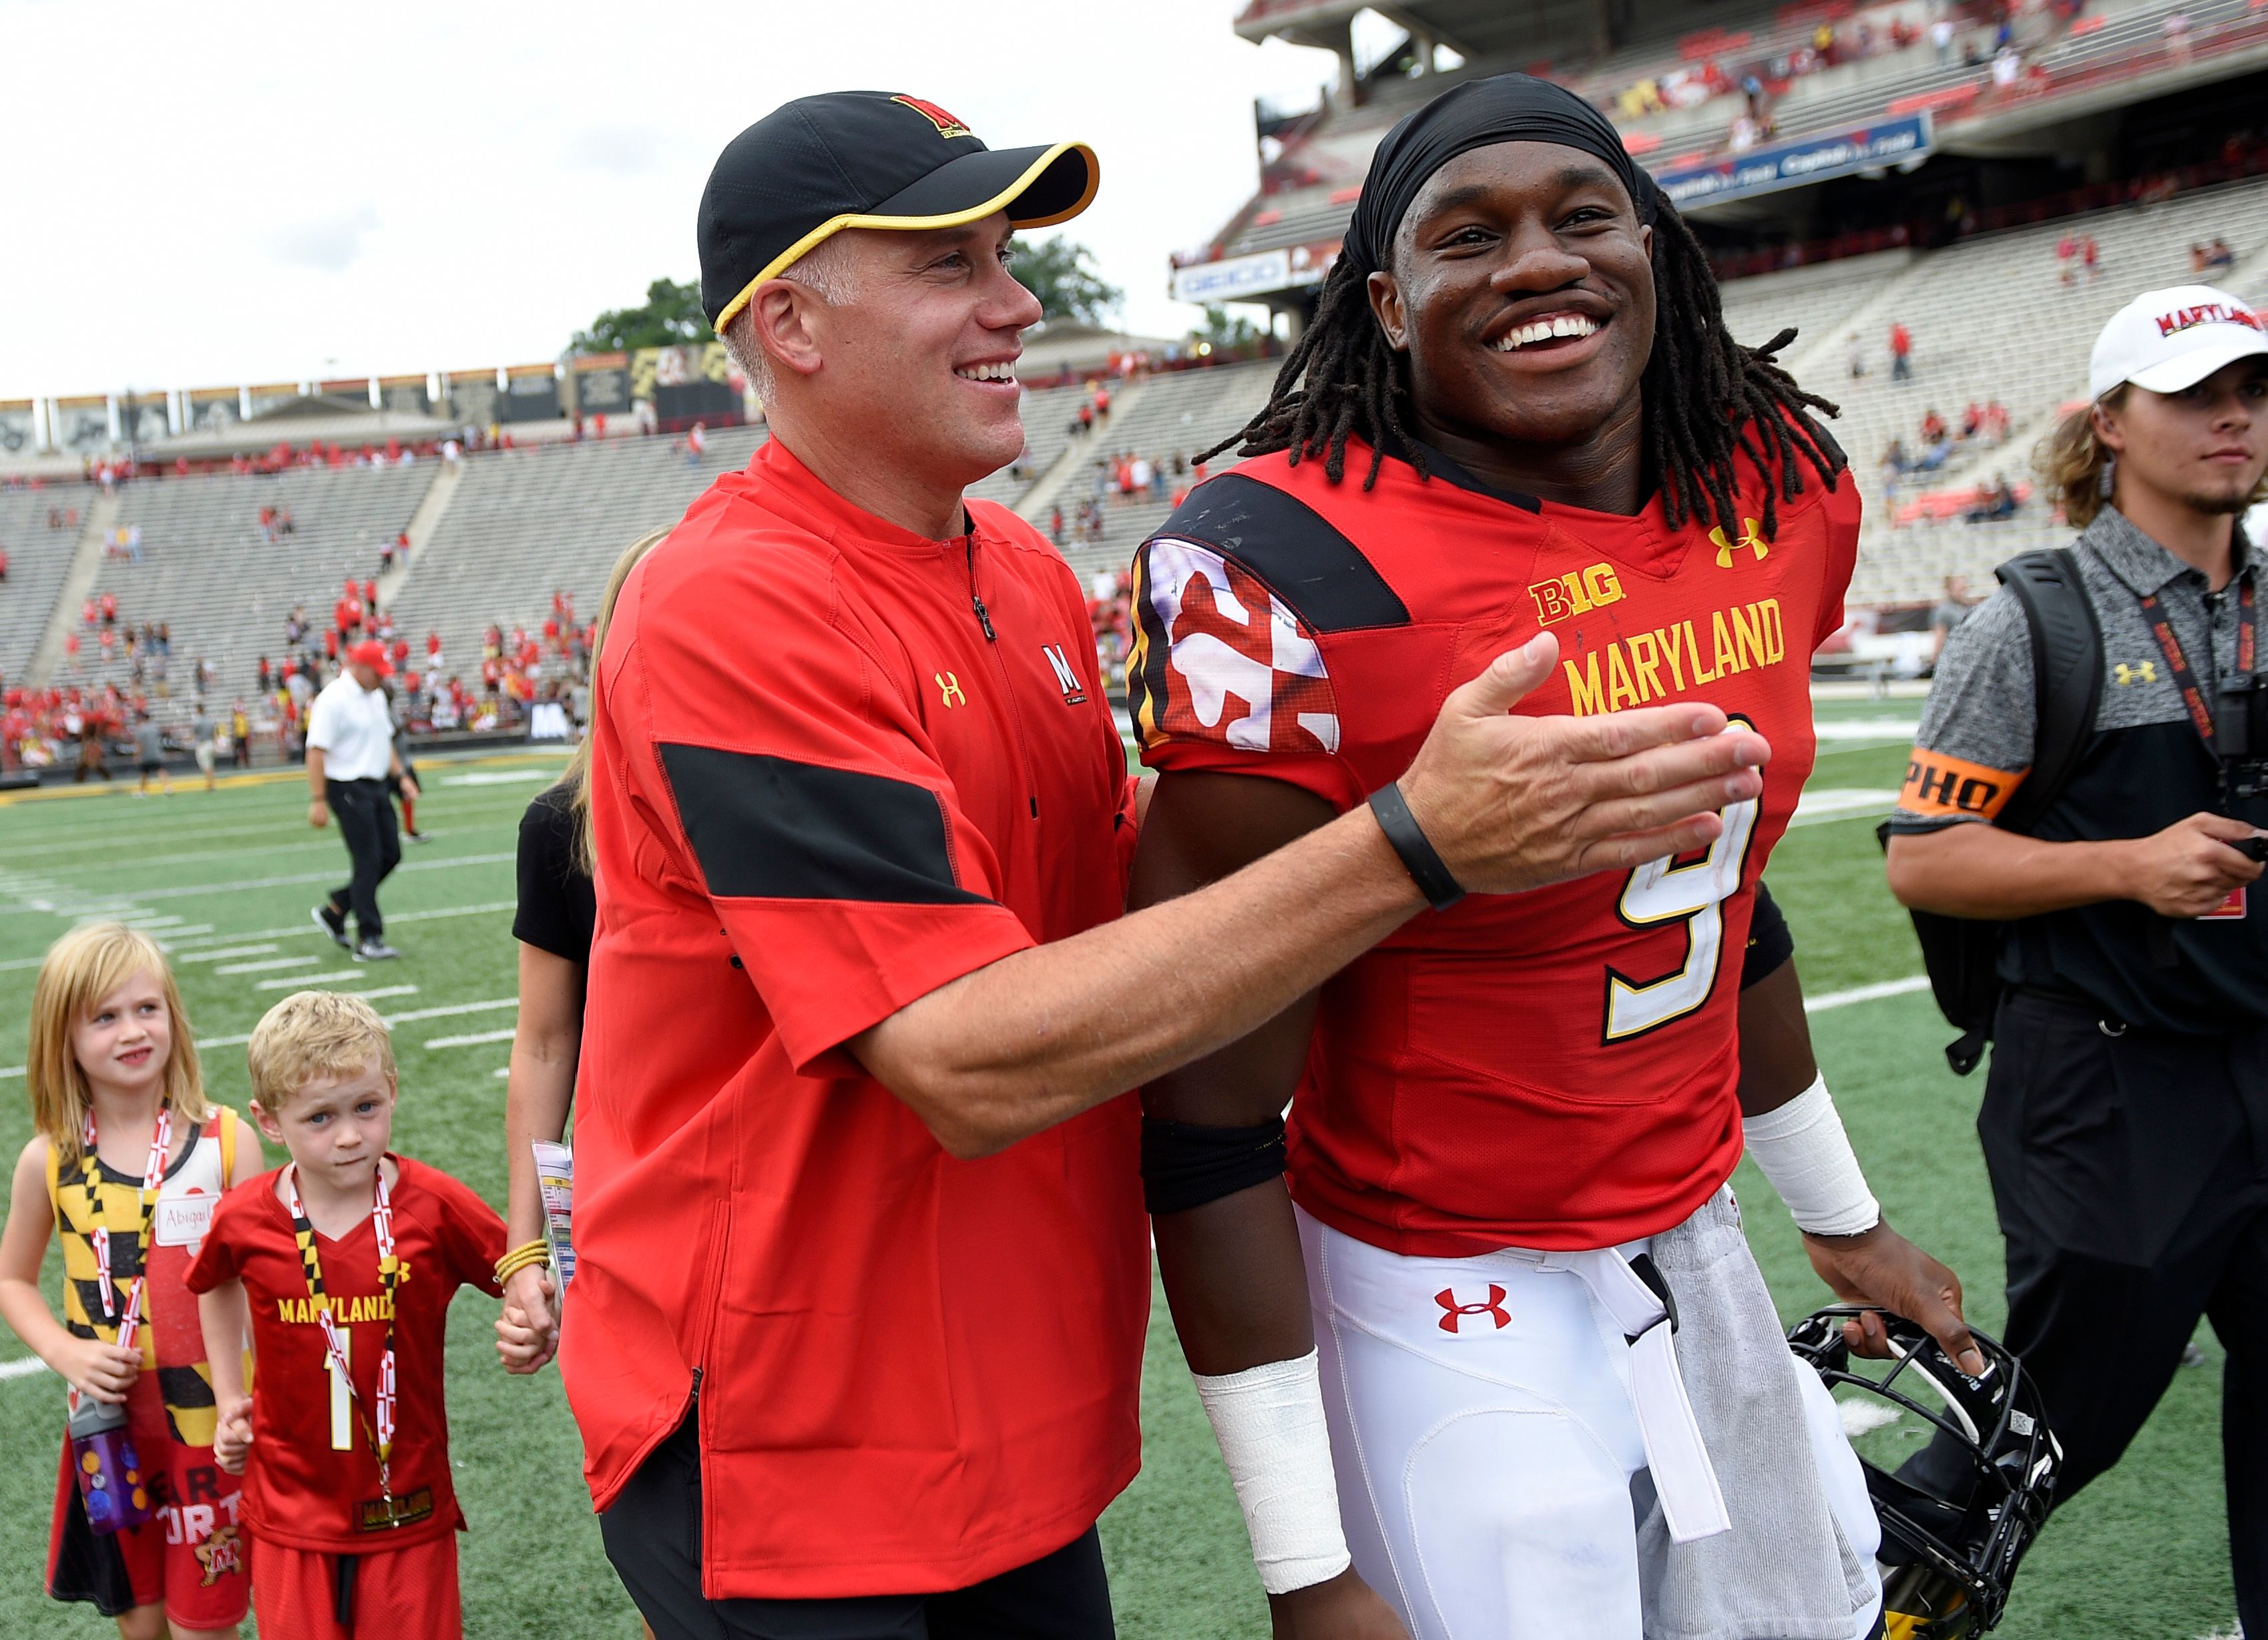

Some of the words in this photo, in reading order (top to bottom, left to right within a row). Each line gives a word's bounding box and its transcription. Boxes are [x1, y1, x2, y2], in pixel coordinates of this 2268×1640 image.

[1042, 643, 1082, 696] M
[1563, 598, 1785, 717] MARYLAND
[1601, 712, 1765, 1047] 9
[324, 1326, 353, 1451] 1
